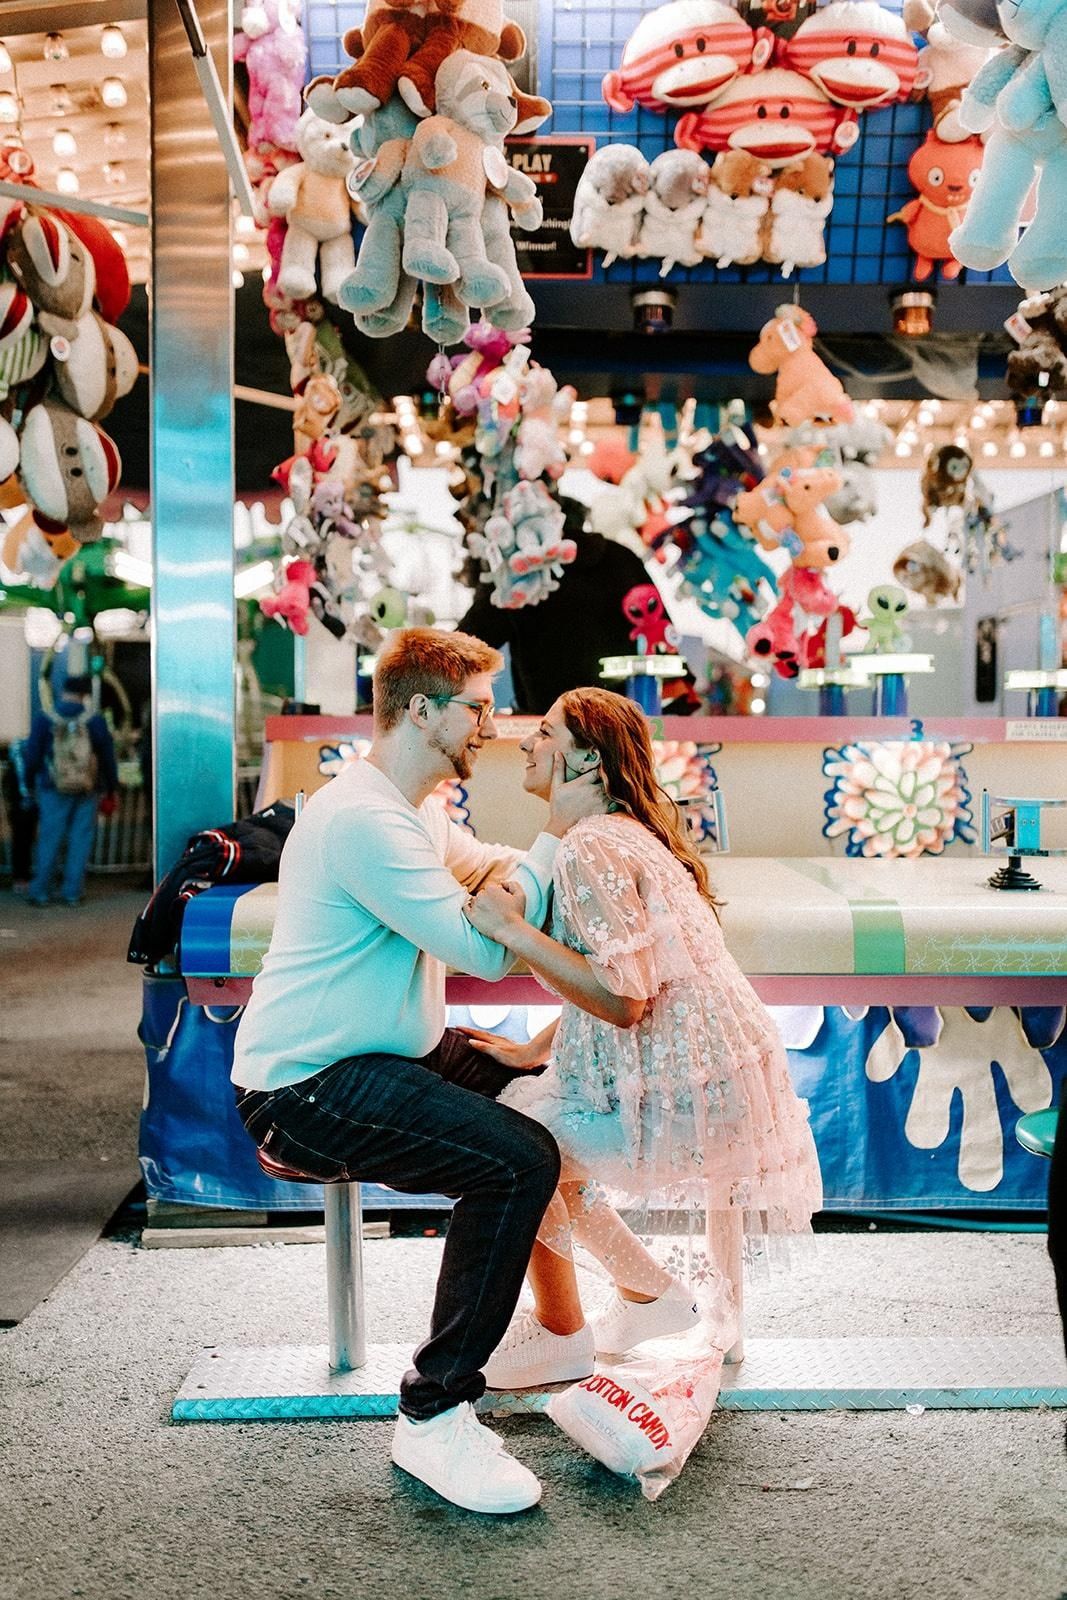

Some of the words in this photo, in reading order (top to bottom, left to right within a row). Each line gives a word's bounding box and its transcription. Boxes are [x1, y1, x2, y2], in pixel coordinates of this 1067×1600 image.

[513, 154, 552, 172] PLAY
[650, 718, 665, 741] 2
[910, 719, 924, 741] 3
[578, 1374, 635, 1412] COTTON
[627, 1402, 672, 1450] CANDY
